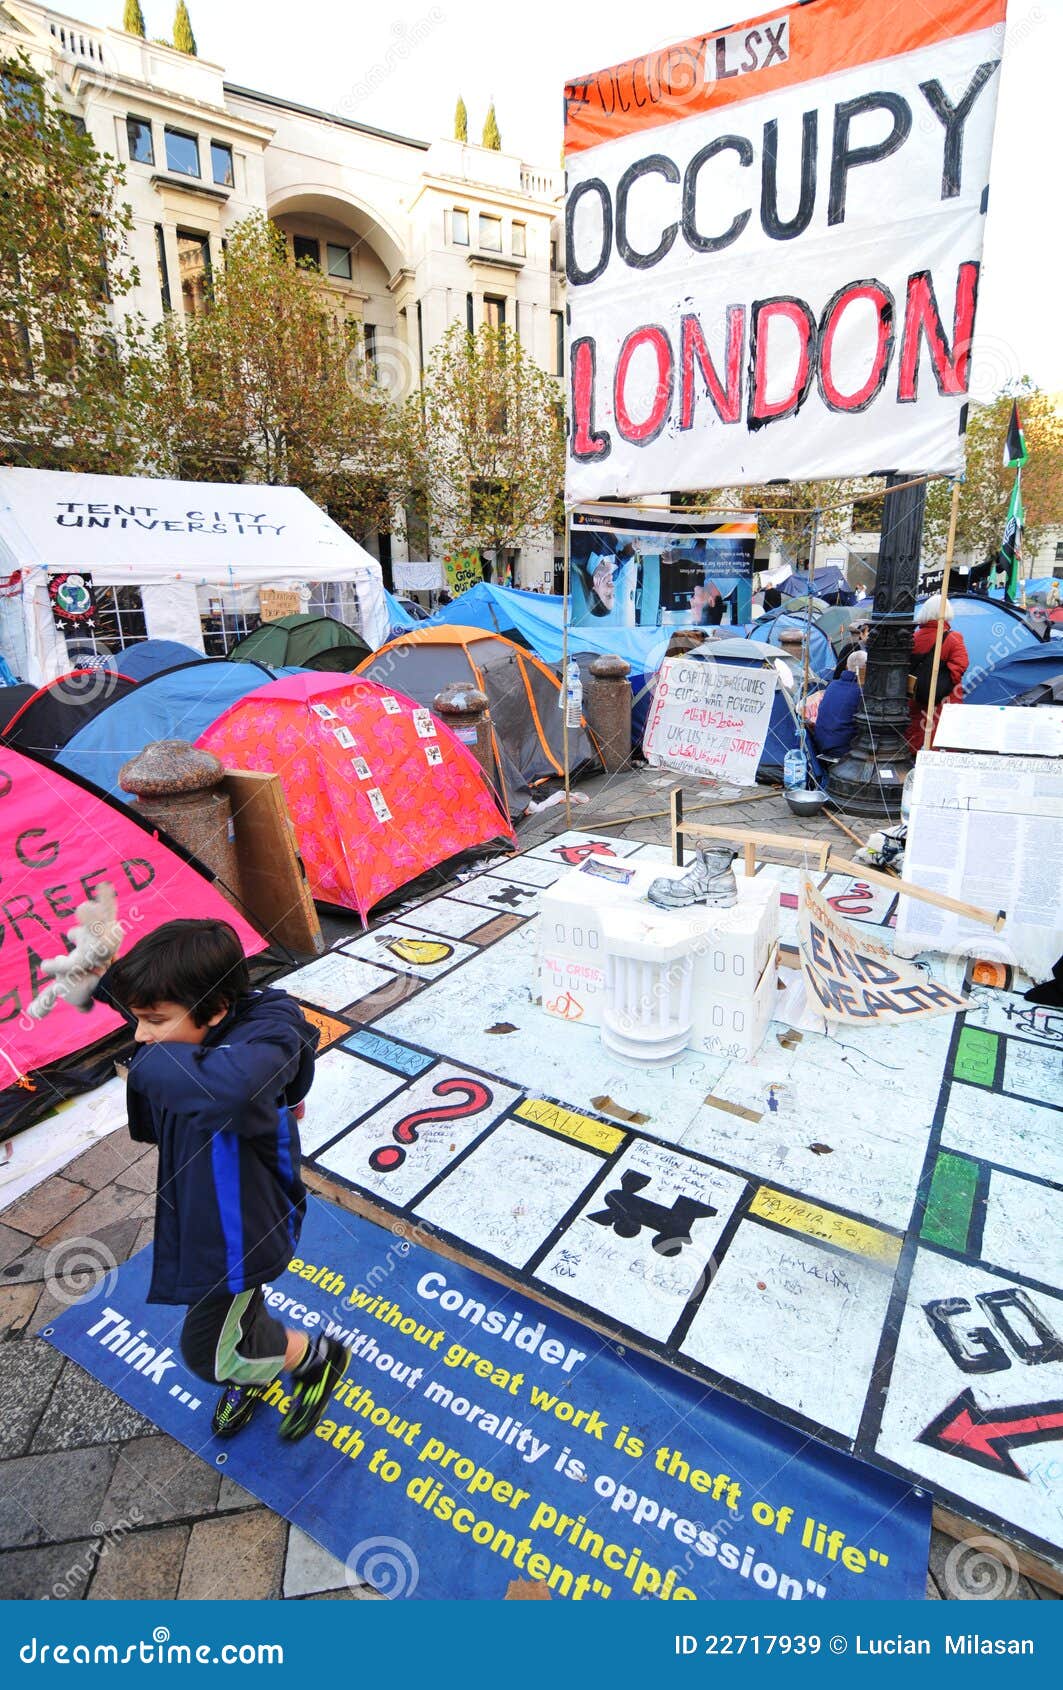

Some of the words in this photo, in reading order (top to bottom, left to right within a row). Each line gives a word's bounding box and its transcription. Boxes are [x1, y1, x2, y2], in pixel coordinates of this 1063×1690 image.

[566, 59, 1001, 286] OCCUPY
[570, 261, 980, 464] LONDON
[55, 514, 287, 535] UNIVERSITY
[56, 503, 158, 516] TENT
[186, 511, 267, 523] CITY
[0, 857, 156, 948] REED
[805, 963, 963, 1018] WEALTH
[810, 920, 900, 985] END
[525, 1102, 583, 1139] WALL
[86, 1307, 177, 1385] Think
[416, 1271, 587, 1374] Consider
[920, 1288, 1063, 1374] GO
[287, 1257, 346, 1296] ealth
[349, 1288, 445, 1351] without
[443, 1343, 525, 1396] great
[529, 1384, 609, 1441] work
[613, 1428, 645, 1459] is
[654, 1447, 742, 1511] theft
[751, 1502, 795, 1536] of
[801, 1516, 890, 1576] life"
[325, 1320, 424, 1388] without
[423, 1380, 552, 1463] morality
[553, 1445, 587, 1482] is
[594, 1472, 827, 1600] oppression"
[333, 1378, 425, 1447] ithout
[417, 1432, 531, 1511] proper
[314, 1419, 365, 1460] ath
[368, 1448, 402, 1483] to
[406, 1474, 612, 1600] discontent"
